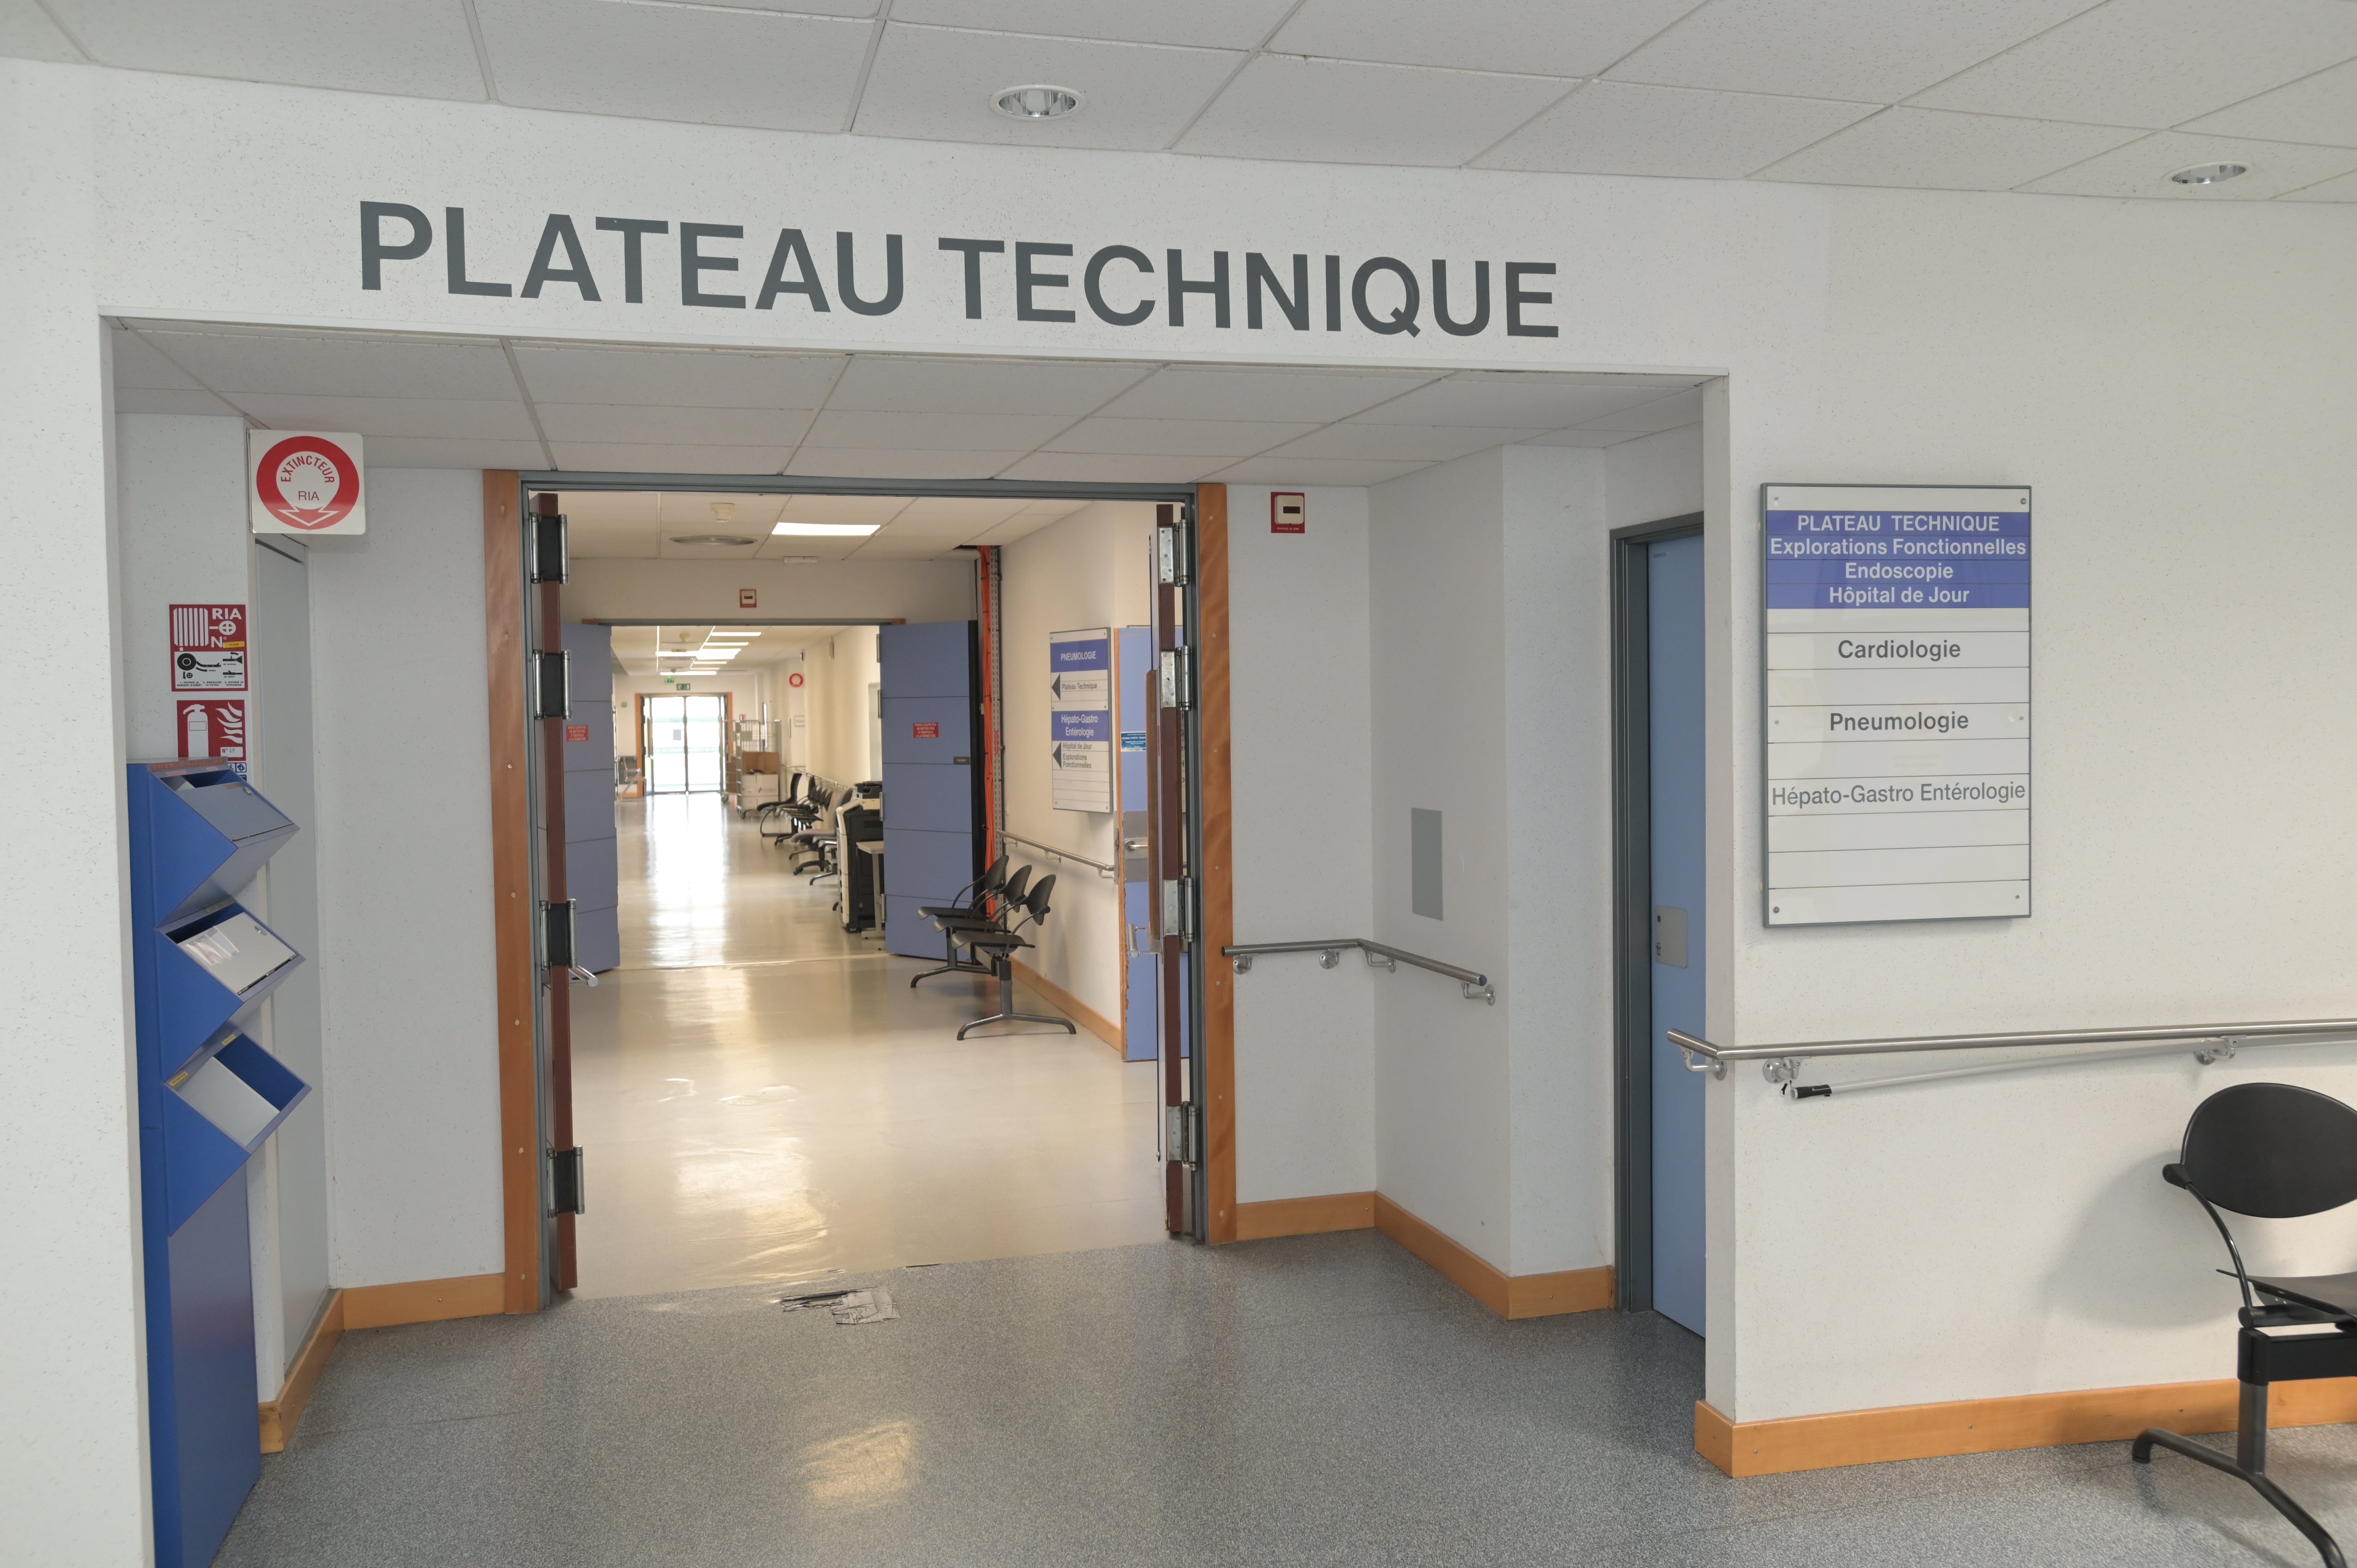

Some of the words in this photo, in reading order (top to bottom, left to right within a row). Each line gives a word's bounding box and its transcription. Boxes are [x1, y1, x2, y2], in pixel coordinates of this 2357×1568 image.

[360, 201, 904, 316] PLATEAU
[938, 237, 1559, 338] TECHNIQUE
[281, 455, 334, 483] EXTINCTEUR
[299, 491, 320, 501] RIA
[1798, 515, 1880, 531] PLATEAU
[1891, 515, 2000, 531] TECHNIQUE
[1771, 538, 1887, 558] Explorations
[1893, 538, 2026, 554] Fonctionnelles
[1845, 562, 1953, 582] Endoscopie
[1829, 586, 1895, 606] Hôpital
[1901, 586, 1923, 603] de
[1928, 586, 1970, 603] Jour
[212, 608, 242, 620] RIA
[211, 636, 227, 648] N°
[1838, 639, 1961, 662] Cardiologie
[1060, 651, 1096, 661] PNEUMOLOGIE
[1077, 682, 1097, 691] Technique
[1061, 714, 1098, 725] Hépato-Gastro
[1830, 711, 1968, 733] Pneumologie
[1065, 727, 1094, 738] Entérologie
[1773, 784, 1914, 809] Hépato-Gastro
[1921, 782, 2025, 803] Entérologie
